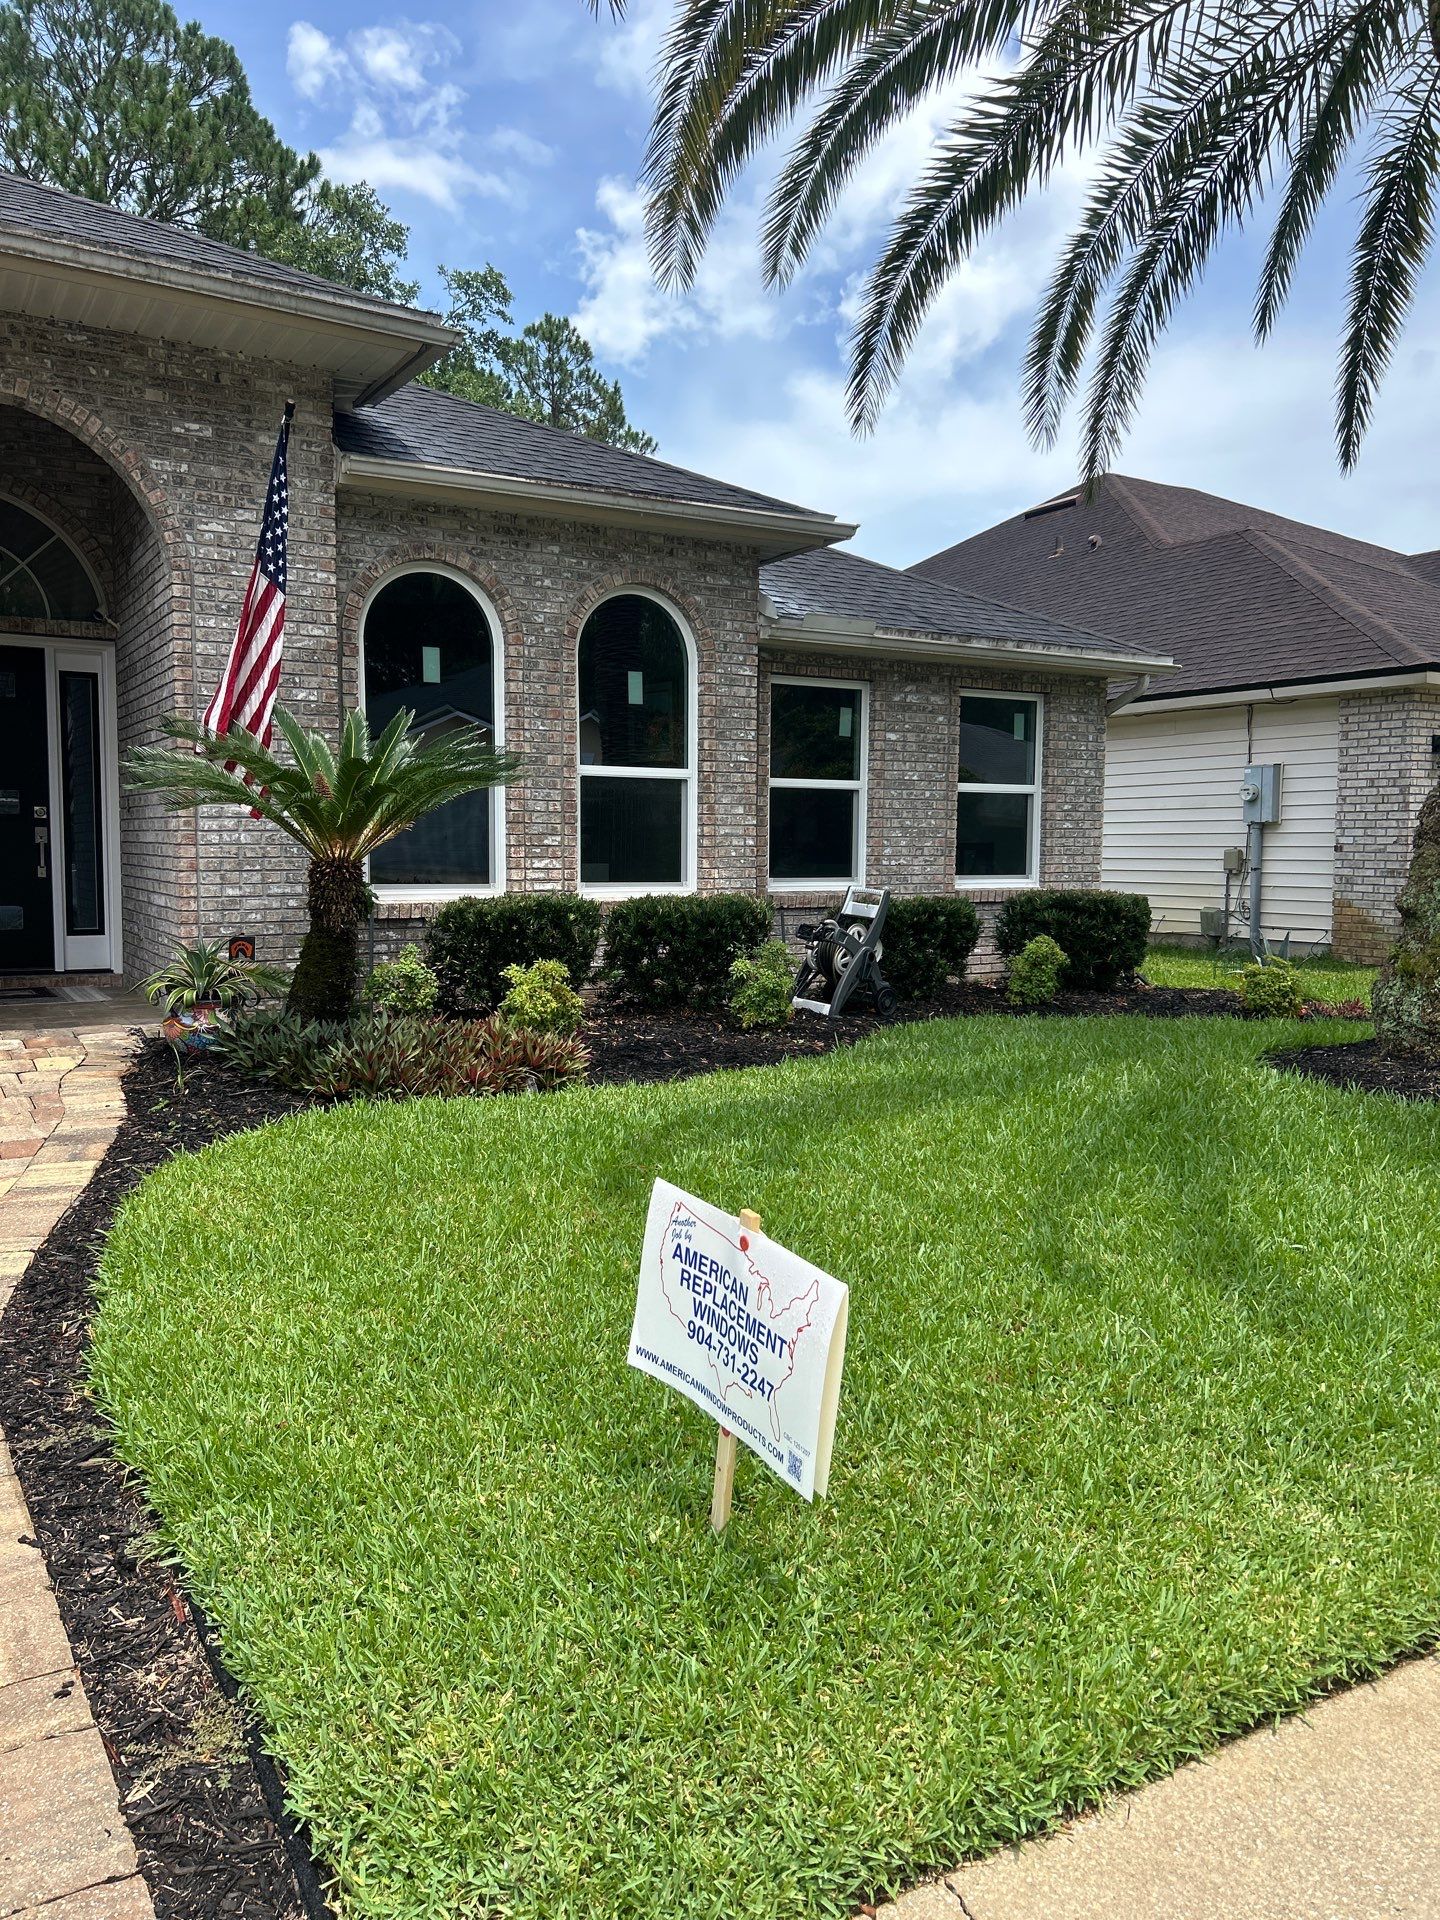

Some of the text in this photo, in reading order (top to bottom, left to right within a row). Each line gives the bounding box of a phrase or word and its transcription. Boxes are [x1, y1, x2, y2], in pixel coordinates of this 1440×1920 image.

[671, 1215, 696, 1227] Another
[671, 1228, 691, 1243] Job by
[672, 1242, 749, 1306] AMERICAN
[680, 1268, 788, 1359] REPLACEMENT
[692, 1297, 759, 1366] WINDOWS
[687, 1320, 774, 1402] 904-731-2247
[635, 1345, 784, 1464] WWW.AMERICANWINDOWPRODUCTS.COM
